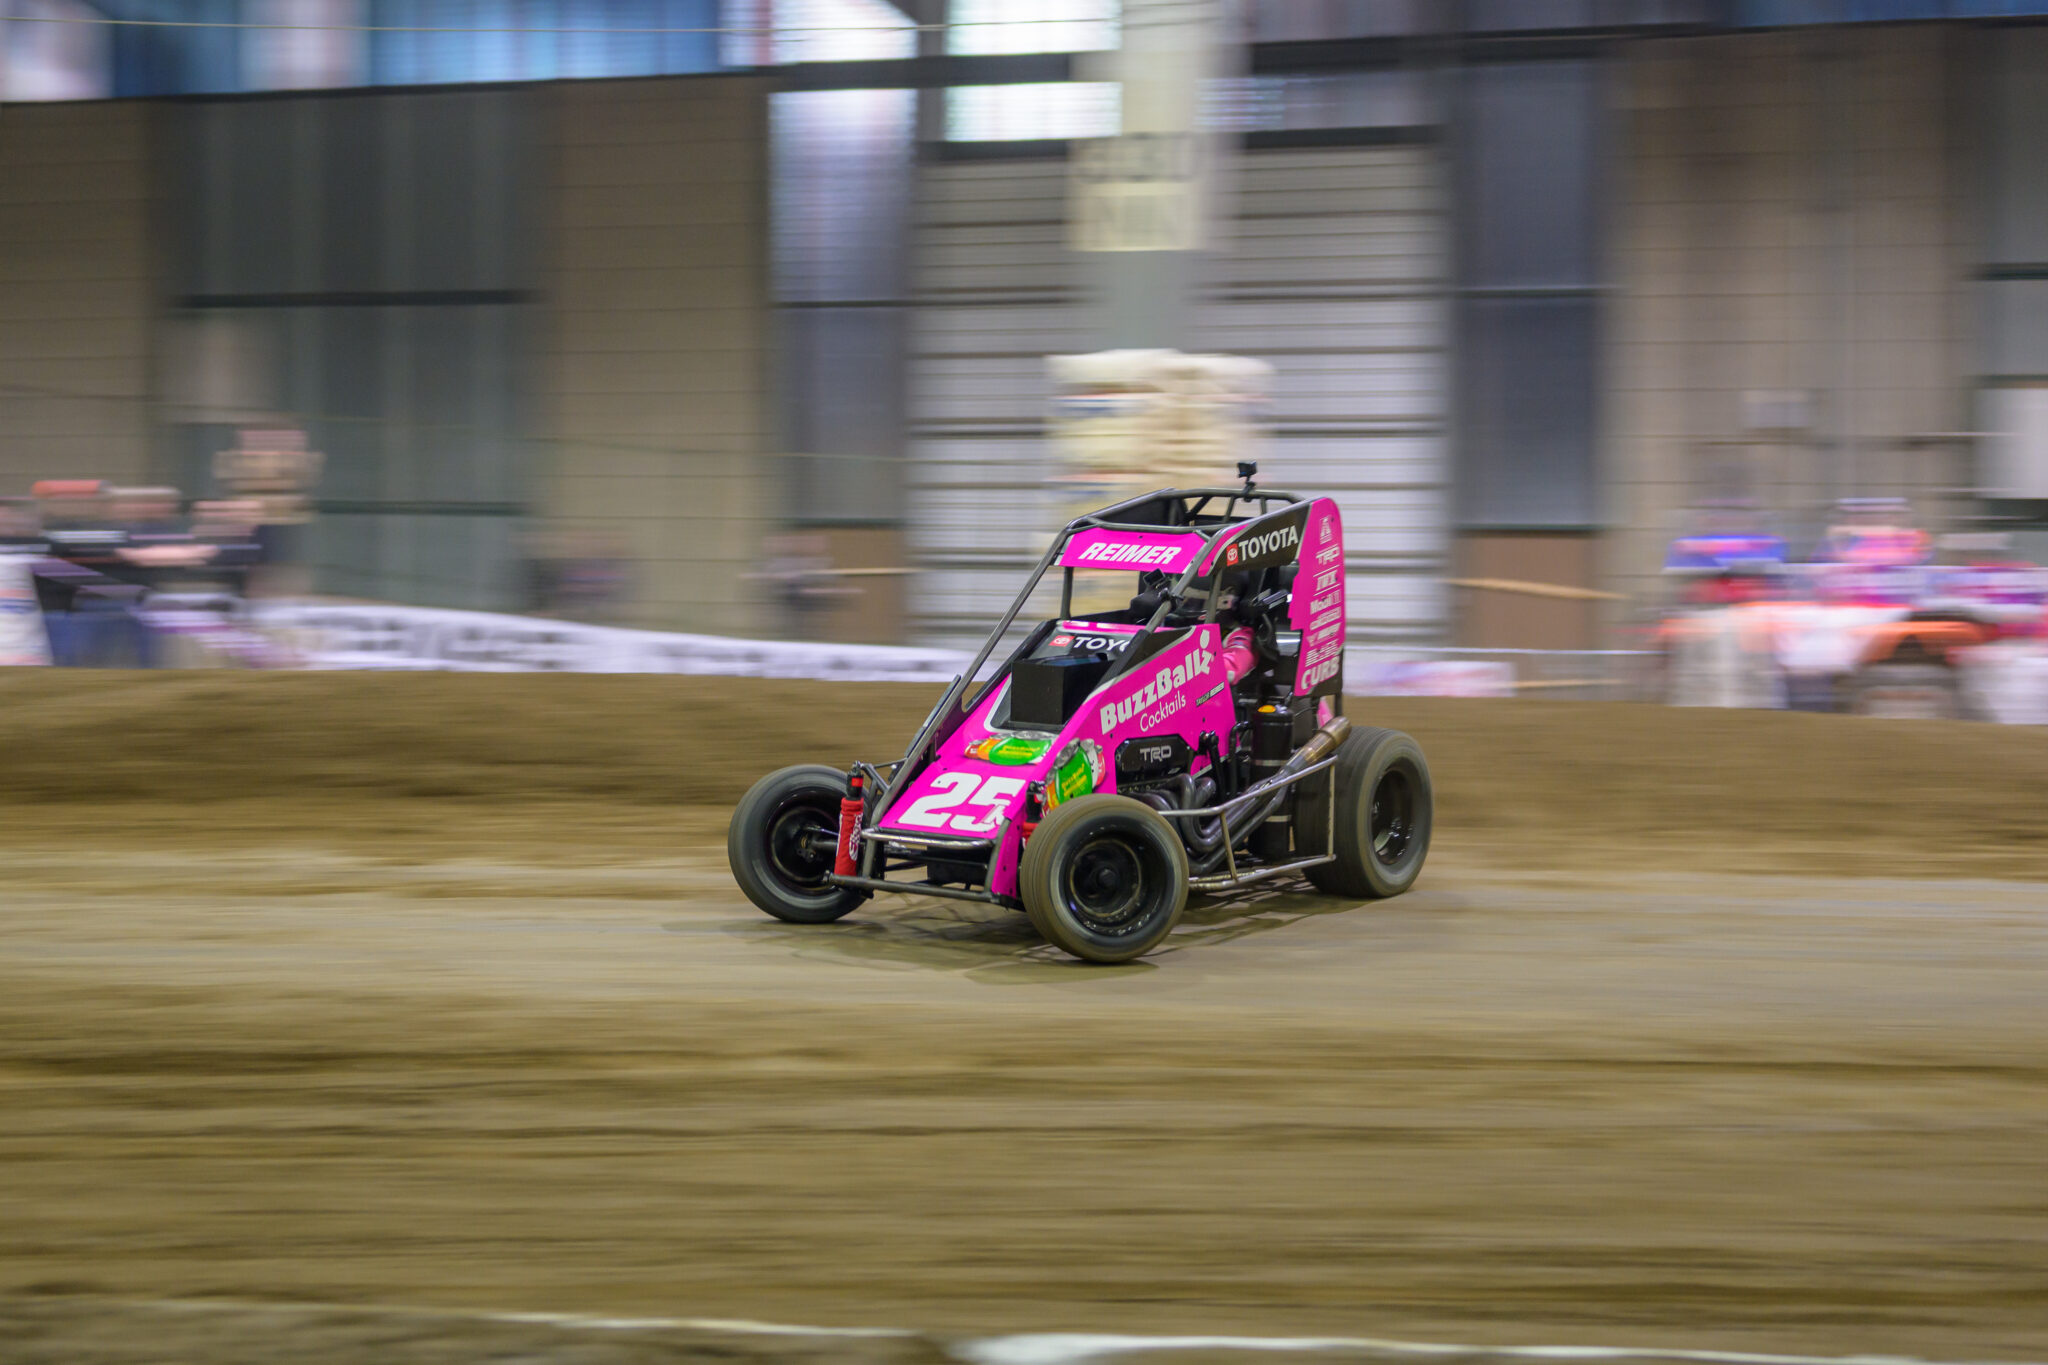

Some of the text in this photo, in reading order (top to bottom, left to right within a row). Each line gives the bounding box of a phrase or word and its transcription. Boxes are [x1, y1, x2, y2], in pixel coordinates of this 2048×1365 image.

[1078, 542, 1182, 564] REIMER
[1238, 525, 1299, 561] TOYOTA
[1073, 637, 1130, 652] TOY
[1301, 656, 1340, 690] CURB
[1140, 690, 1186, 732] Cocktails
[1140, 745, 1171, 763] TRD
